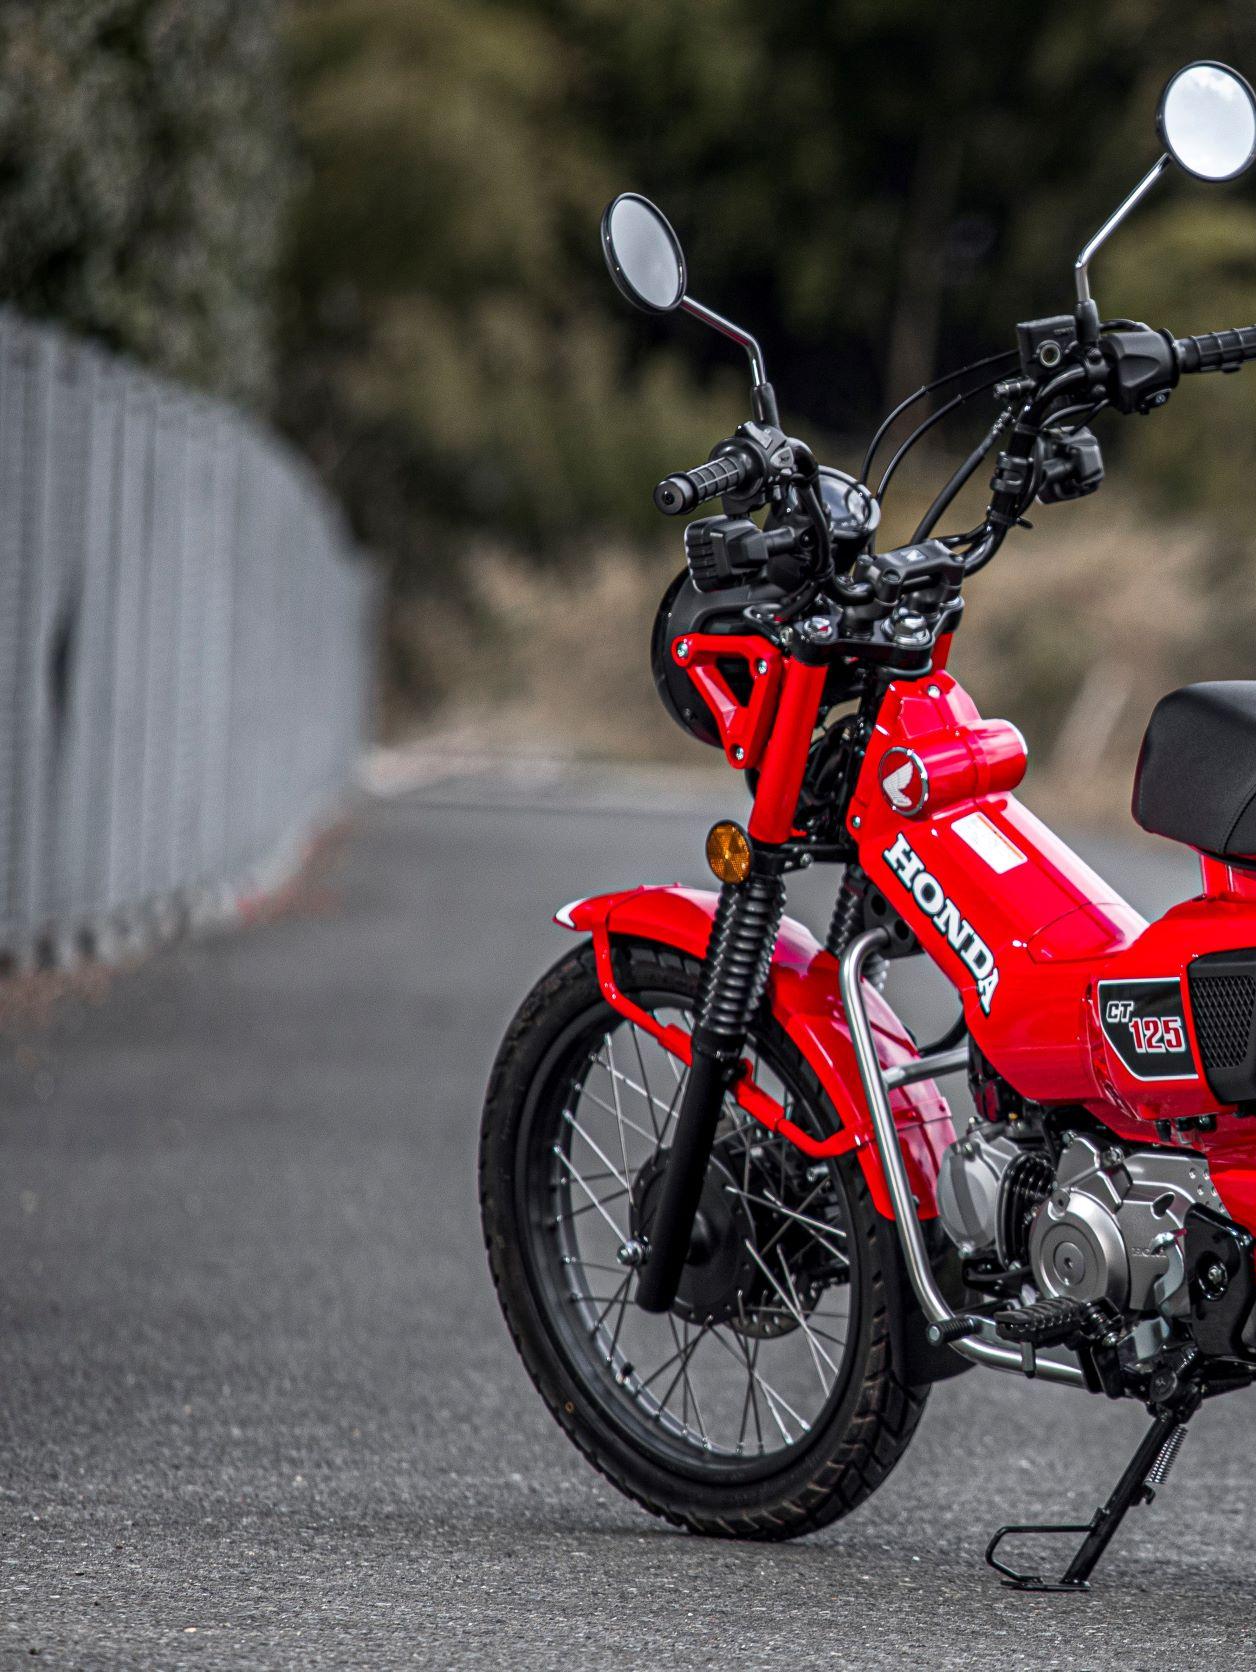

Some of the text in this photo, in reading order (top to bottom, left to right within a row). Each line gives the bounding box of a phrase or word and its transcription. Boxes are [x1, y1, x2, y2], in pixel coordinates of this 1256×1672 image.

[883, 832, 999, 1016] HONDA
[1106, 1001, 1134, 1023] CT
[1128, 1016, 1186, 1053] 125
